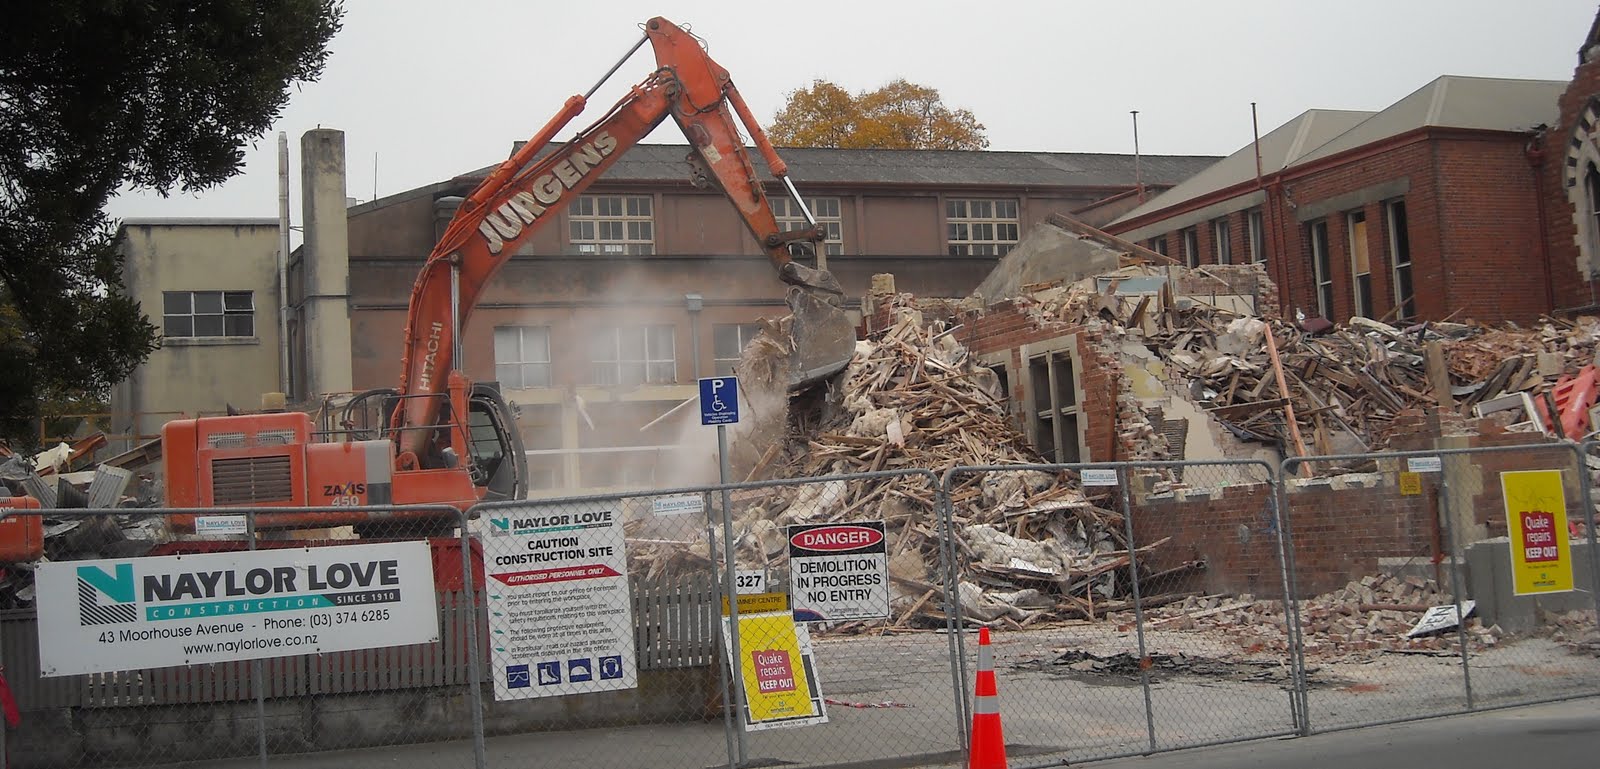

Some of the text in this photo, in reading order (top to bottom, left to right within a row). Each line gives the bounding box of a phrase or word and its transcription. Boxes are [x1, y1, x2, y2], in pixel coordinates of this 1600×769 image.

[478, 130, 618, 255] JURGENS
[419, 321, 443, 391] HITACHI
[712, 379, 724, 394] P
[323, 482, 365, 496] ZAXIS
[331, 496, 359, 506] 450
[513, 515, 570, 529] NAYLOR
[574, 511, 612, 523] LOVE
[1525, 515, 1549, 530] Quake
[528, 537, 578, 550] CAUTION
[803, 531, 870, 546] DANGER
[1526, 530, 1551, 544] repairs
[496, 546, 613, 566] CONSTRUCTION SITE
[1525, 546, 1557, 558] KEEP OUT
[800, 559, 877, 574] DEMOLITION
[143, 560, 399, 602] NAYLOR LOVE
[507, 567, 605, 582] AUTHORISED PERSONNEL ONLY
[737, 575, 762, 588] 327
[797, 573, 881, 588] IN PROGRESS
[337, 592, 394, 604] SINCE 1910
[808, 588, 872, 603] NO ENTRY
[153, 598, 319, 618] CONSTRUCTION
[98, 627, 115, 644] 43
[118, 624, 192, 642] Moorhouse
[196, 620, 244, 636] Avenue
[264, 617, 306, 631] Phone:
[310, 615, 332, 629] (03)
[336, 612, 357, 624] 374
[362, 609, 390, 622] 6285
[184, 634, 318, 656] www.naylorlove.co.nz
[758, 653, 783, 666] Quake
[760, 666, 786, 679] repairs
[760, 678, 793, 690] KEEP OUT
